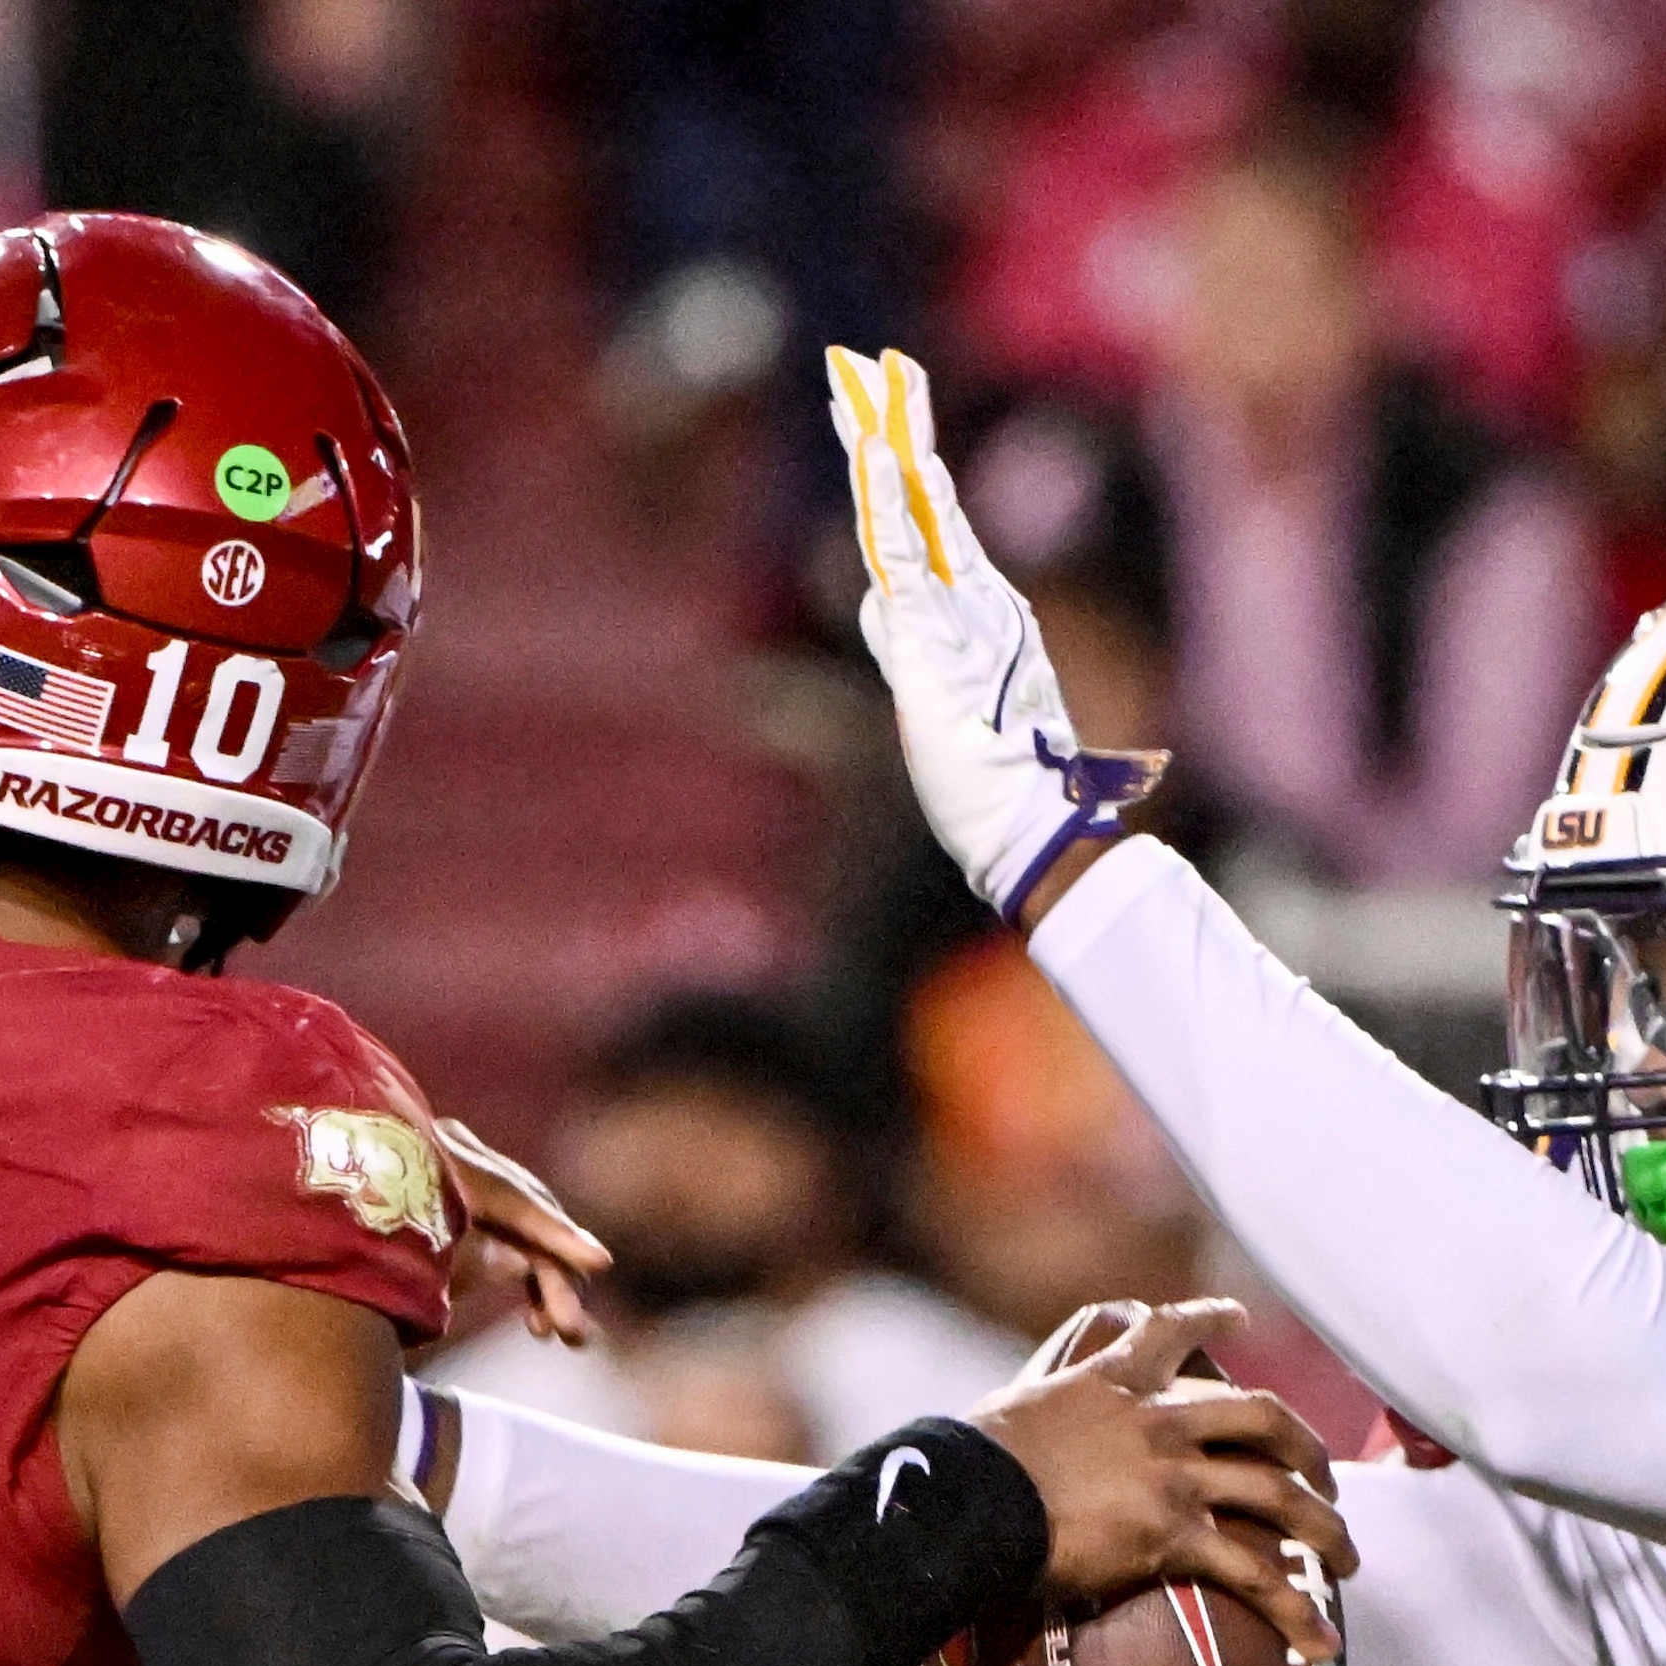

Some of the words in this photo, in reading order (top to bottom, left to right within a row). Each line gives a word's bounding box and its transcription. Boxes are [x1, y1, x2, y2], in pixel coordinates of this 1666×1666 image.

[225, 464, 284, 499] C2P
[208, 544, 262, 602] SEC
[122, 639, 286, 785] 10
[1541, 808, 1606, 850] LSU
